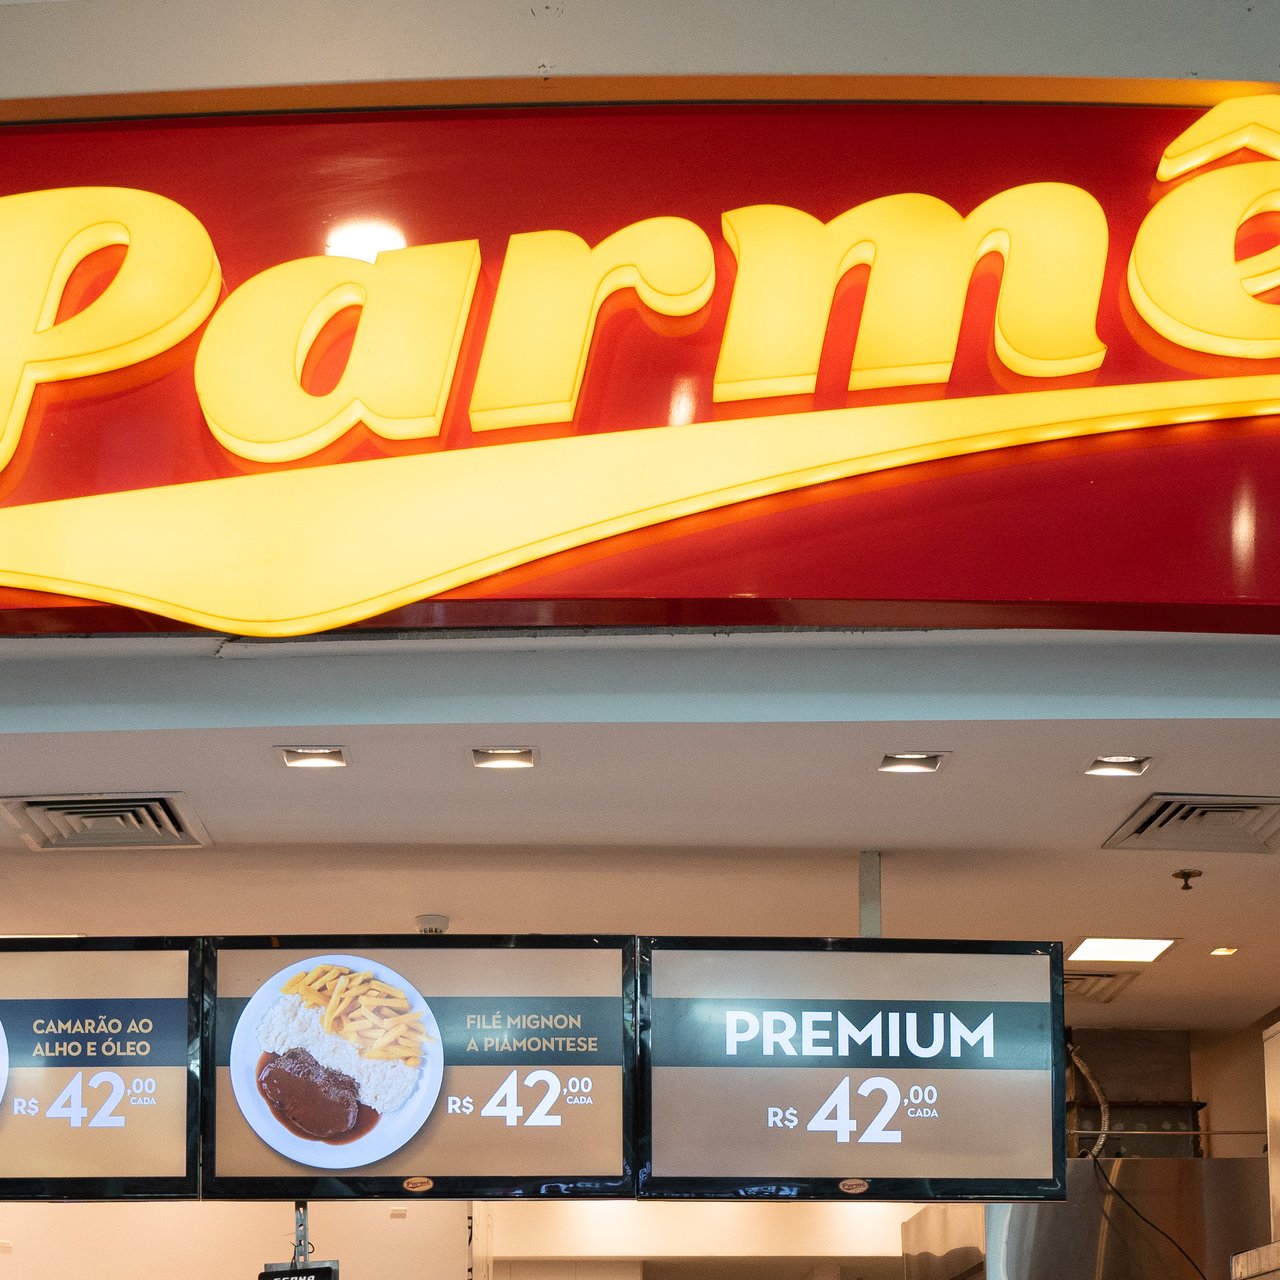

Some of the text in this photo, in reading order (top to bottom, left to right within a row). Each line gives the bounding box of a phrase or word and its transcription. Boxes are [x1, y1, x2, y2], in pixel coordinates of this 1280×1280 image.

[33, 1014, 154, 1035] CAMARÃO AO
[466, 1011, 582, 1030] FILÉ MIGNON
[466, 1036, 479, 1052] A
[725, 1010, 994, 1058] PREMIUM
[32, 1035, 151, 1057] ALHO E ÓLEO
[13, 1096, 39, 1117] R$
[129, 1096, 157, 1105] CADA
[447, 1096, 474, 1116] R$
[566, 1095, 594, 1105] CADA
[767, 1107, 799, 1128] R$
[907, 1108, 939, 1118] CADA
